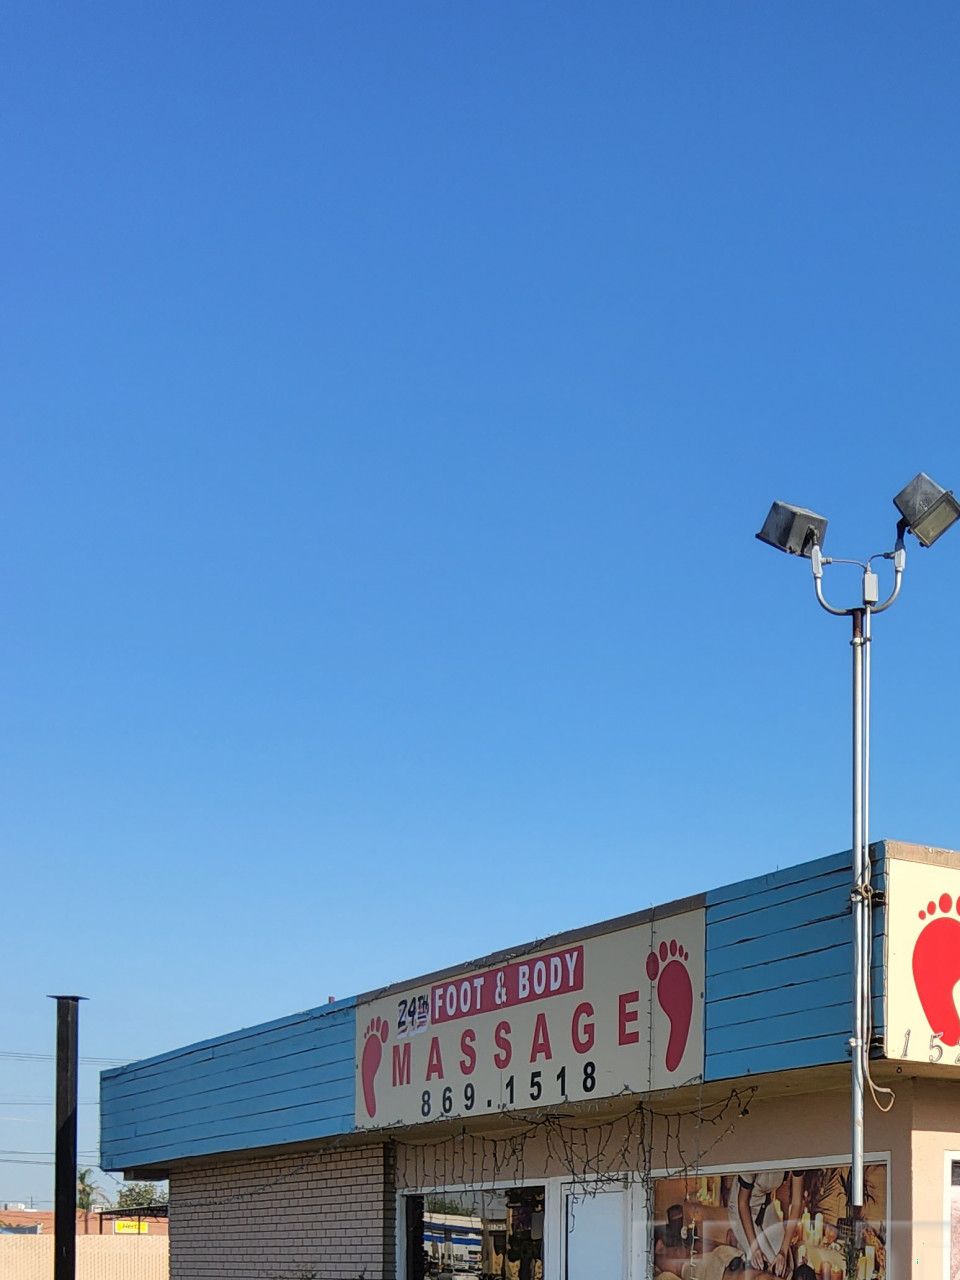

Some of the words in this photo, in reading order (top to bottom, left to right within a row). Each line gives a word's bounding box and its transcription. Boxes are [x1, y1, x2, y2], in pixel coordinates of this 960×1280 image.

[434, 977, 484, 1020] FOOT
[495, 971, 507, 1004] &
[518, 951, 579, 999] BODY
[391, 990, 640, 1087] MASSAGE
[420, 1061, 597, 1117] 869.1518
